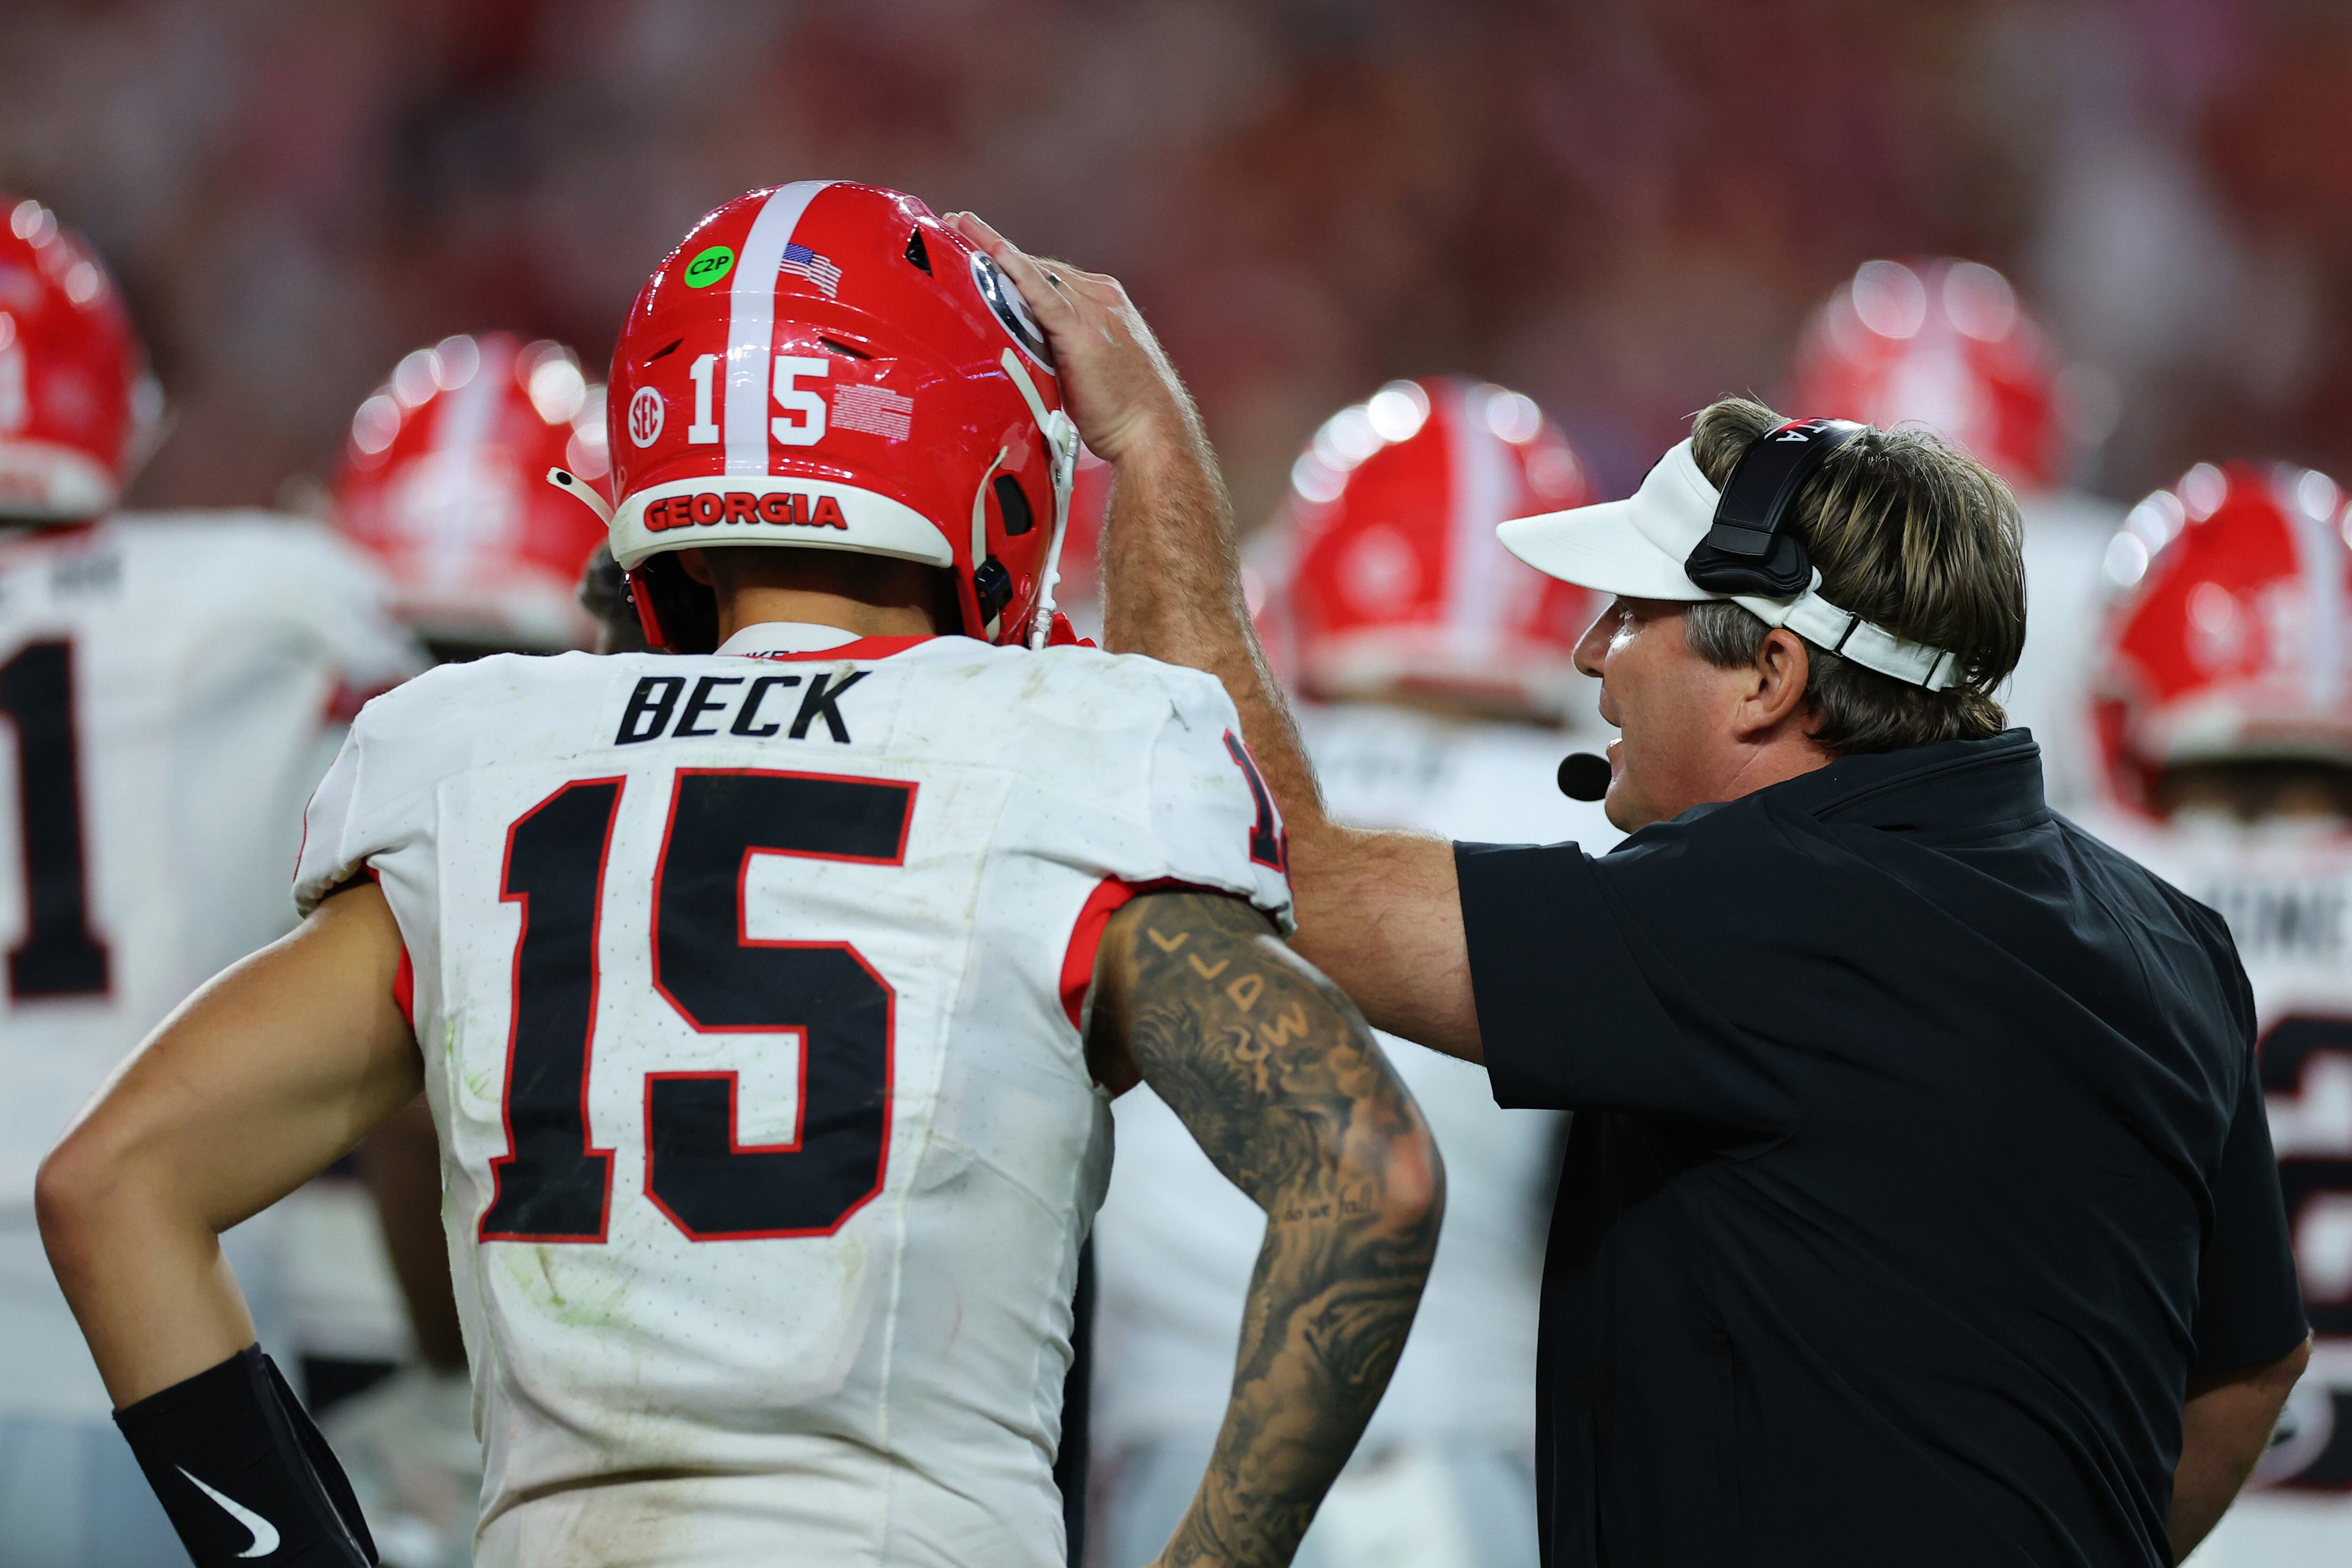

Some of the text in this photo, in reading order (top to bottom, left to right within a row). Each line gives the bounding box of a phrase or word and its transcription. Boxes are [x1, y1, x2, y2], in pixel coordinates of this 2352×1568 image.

[690, 255, 730, 276] C2P
[632, 393, 659, 441] SEC
[643, 491, 848, 533] GEORGIA
[614, 671, 873, 746] BECK
[1223, 728, 1294, 896] 1
[479, 768, 920, 1244] 15
